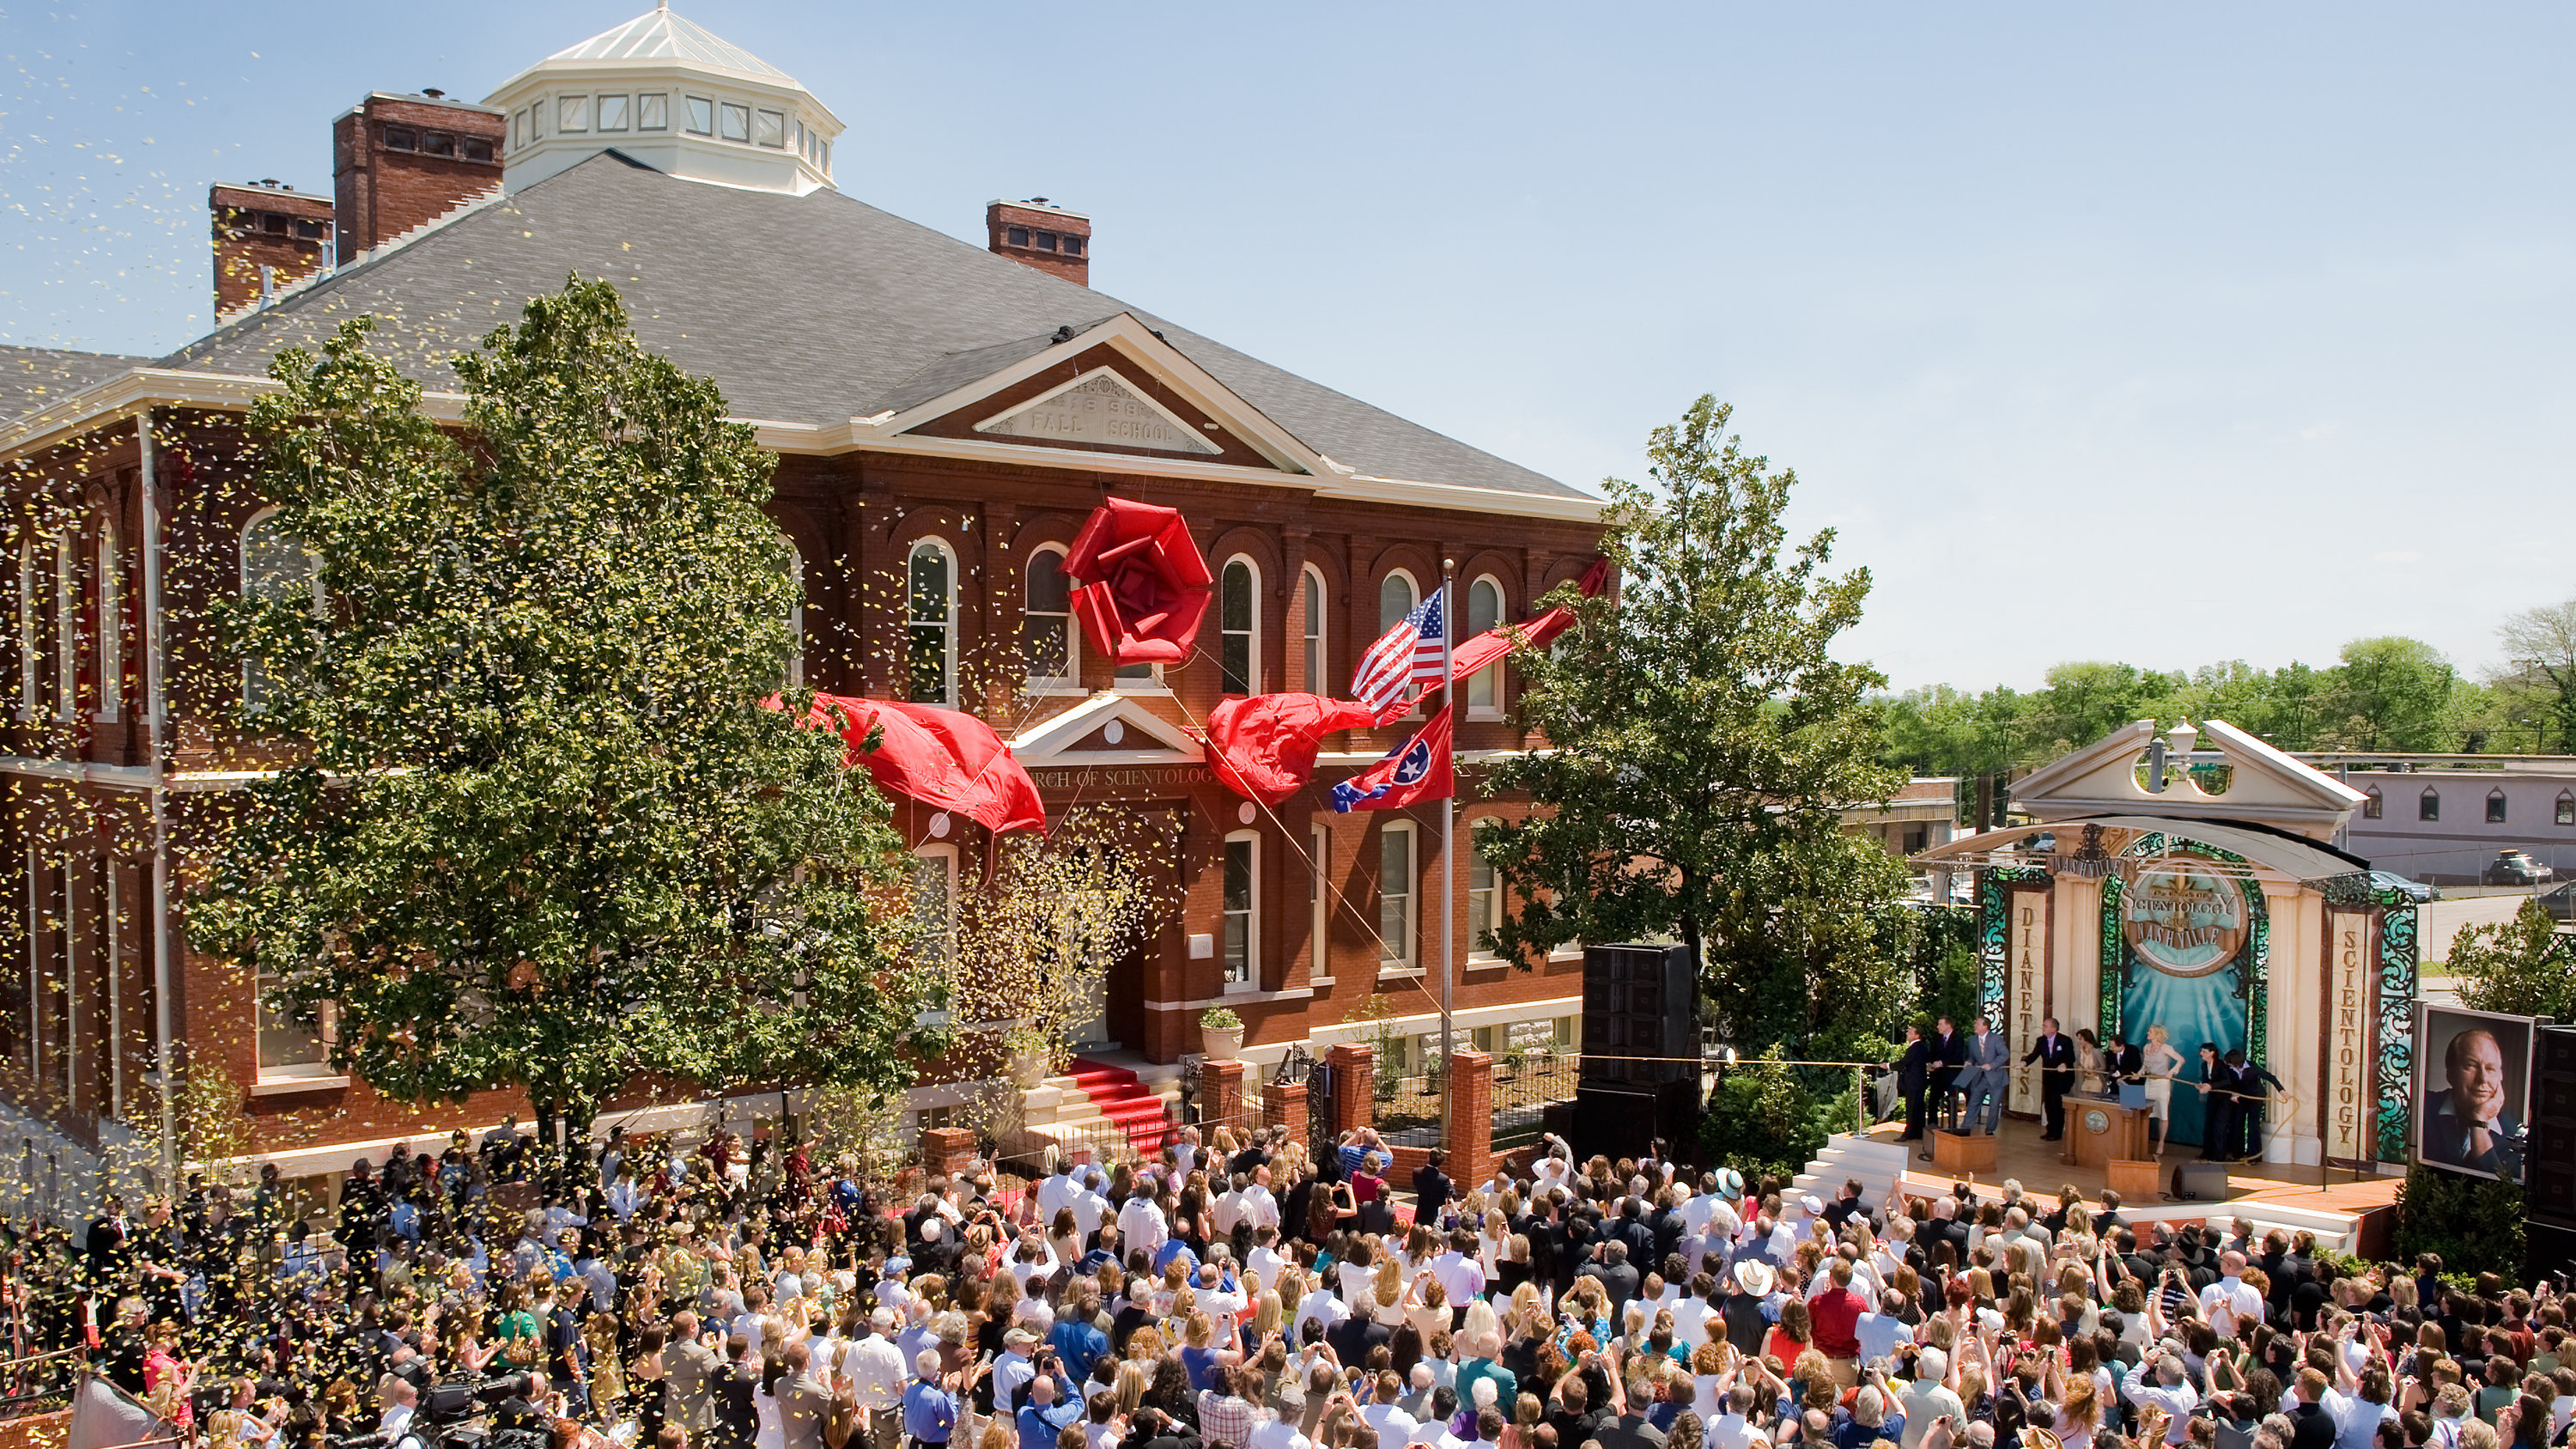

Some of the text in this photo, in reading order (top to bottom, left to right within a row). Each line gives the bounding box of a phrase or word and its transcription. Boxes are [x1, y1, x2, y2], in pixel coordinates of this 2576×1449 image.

[1031, 411, 1174, 442] FALL SCHOOL
[1031, 767, 1213, 788] RCH OF SCIENTOLOG
[2055, 856, 2121, 878] NASHVILLE
[2120, 888, 2236, 915] SCIENTOLOGY
[2136, 922, 2220, 948] NASHVILLE
[2337, 930, 2356, 1144] SCIENTOLOGY
